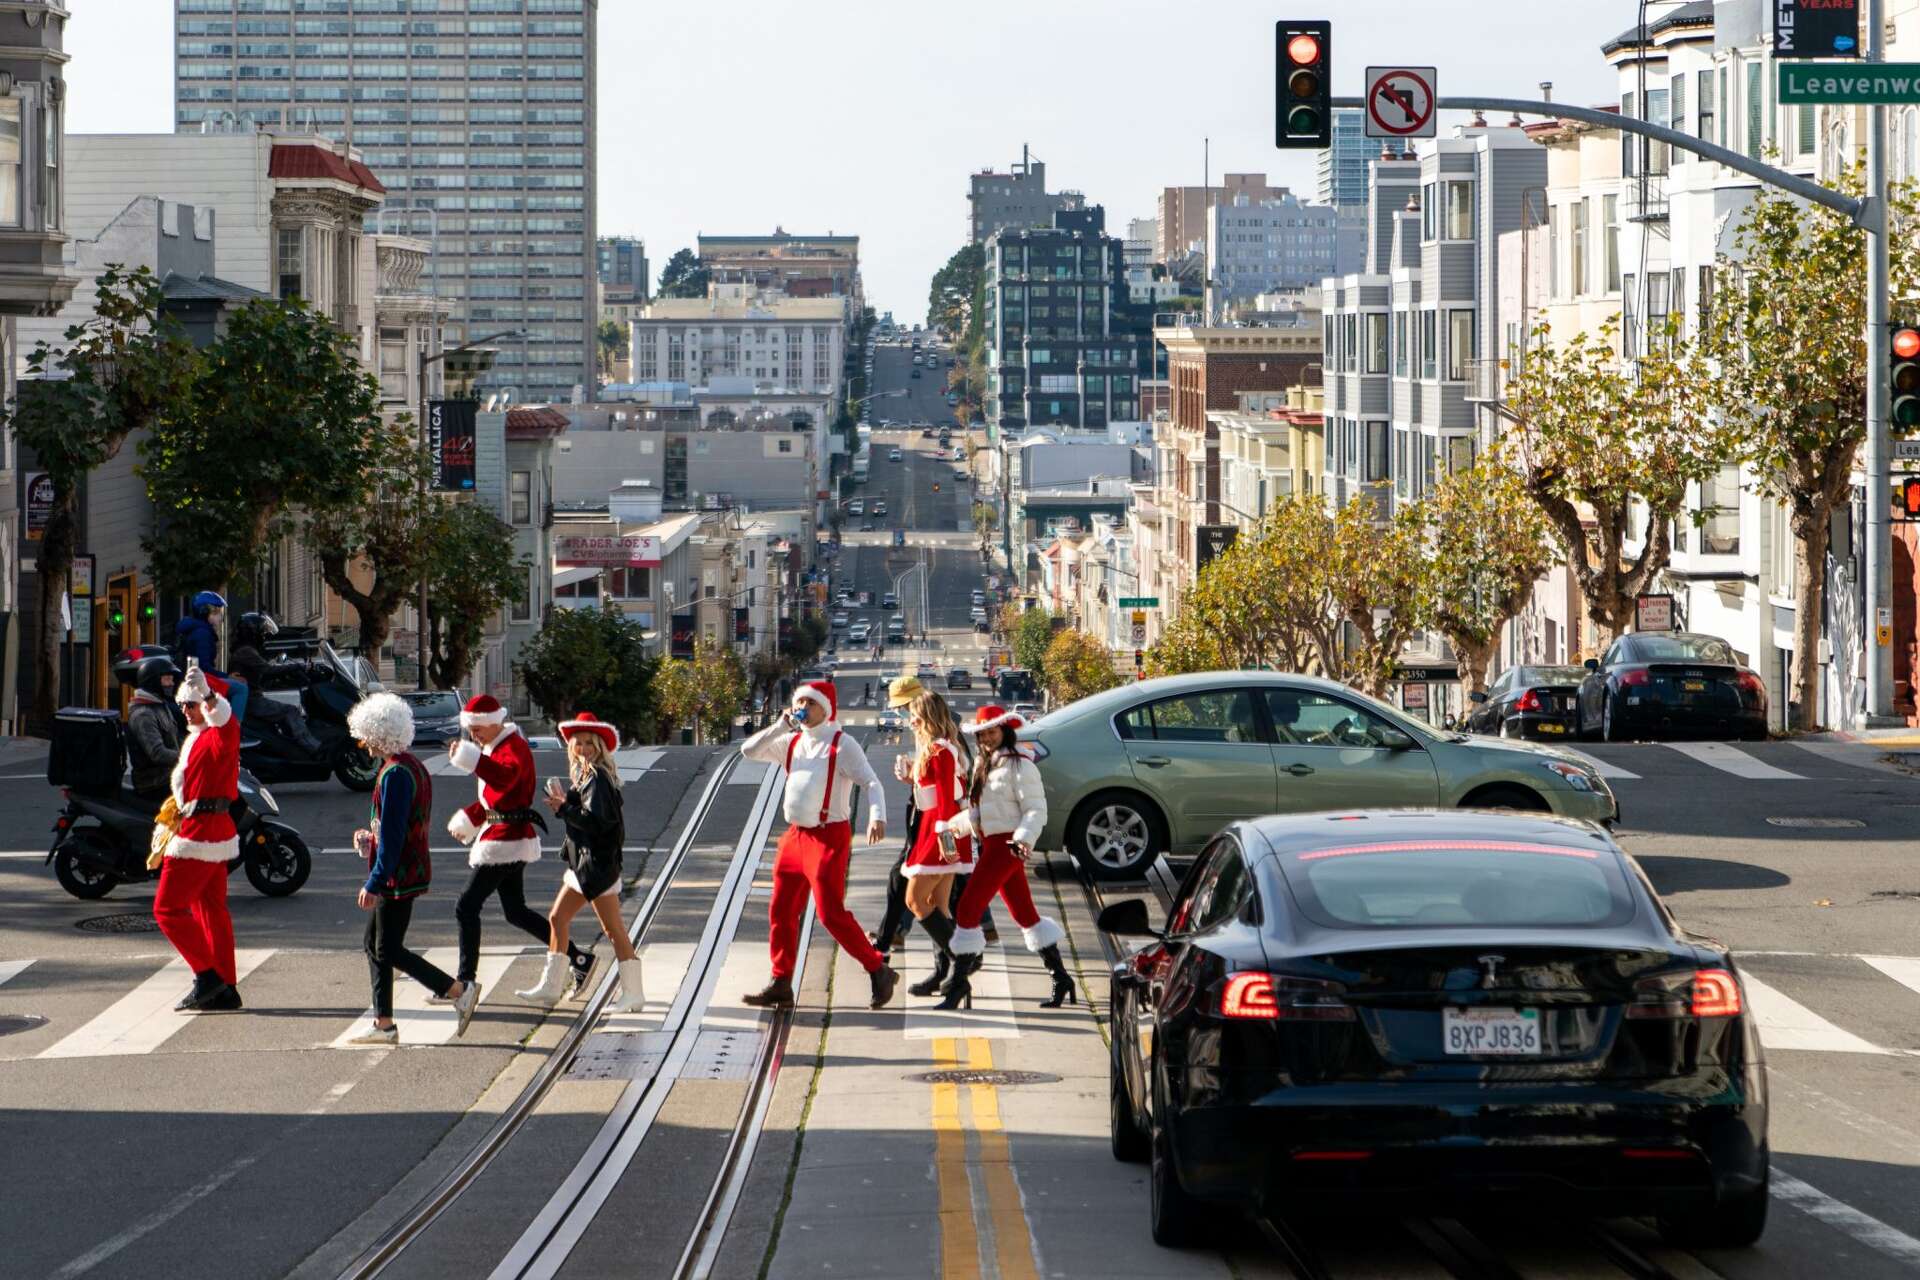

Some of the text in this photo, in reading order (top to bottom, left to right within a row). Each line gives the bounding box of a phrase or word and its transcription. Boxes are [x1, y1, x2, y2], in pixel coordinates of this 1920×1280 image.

[432, 406, 442, 488] METALLICA
[616, 538, 651, 549] JOE'S
[1450, 1025, 1535, 1049] 8XPJ836
